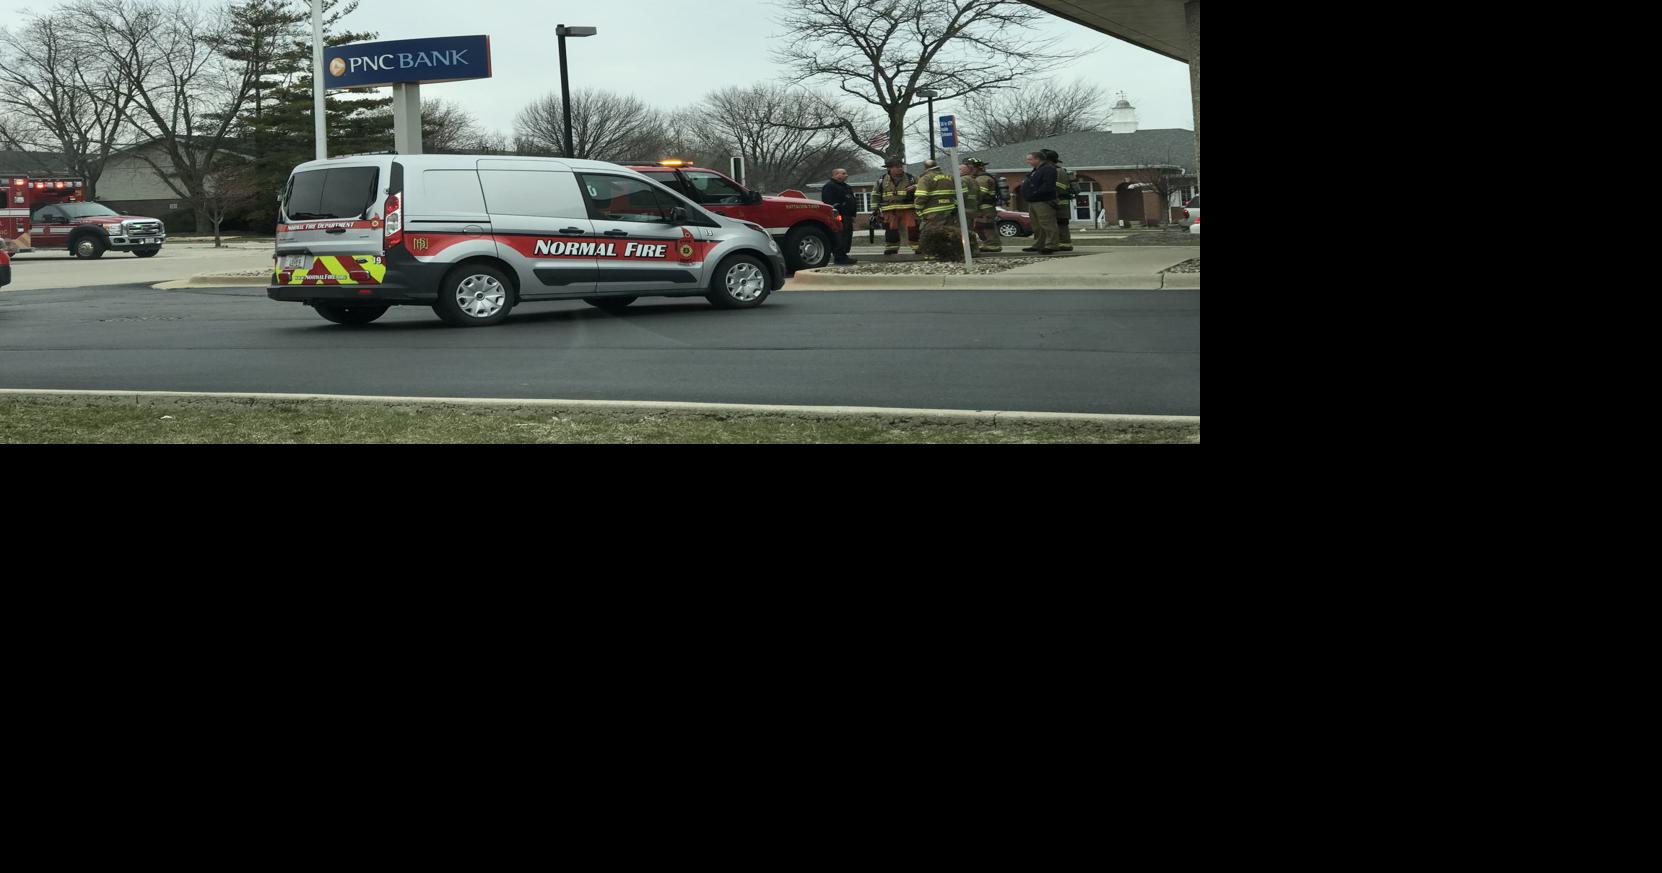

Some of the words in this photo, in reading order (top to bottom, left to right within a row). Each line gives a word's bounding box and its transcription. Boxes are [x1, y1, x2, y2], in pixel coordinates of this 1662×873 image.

[349, 54, 394, 73] PNC
[397, 49, 469, 69] BANK
[317, 221, 355, 229] DEPARTMENT
[533, 239, 617, 257] NORMAL
[624, 242, 667, 259] FIRE
[372, 256, 382, 265] 19
